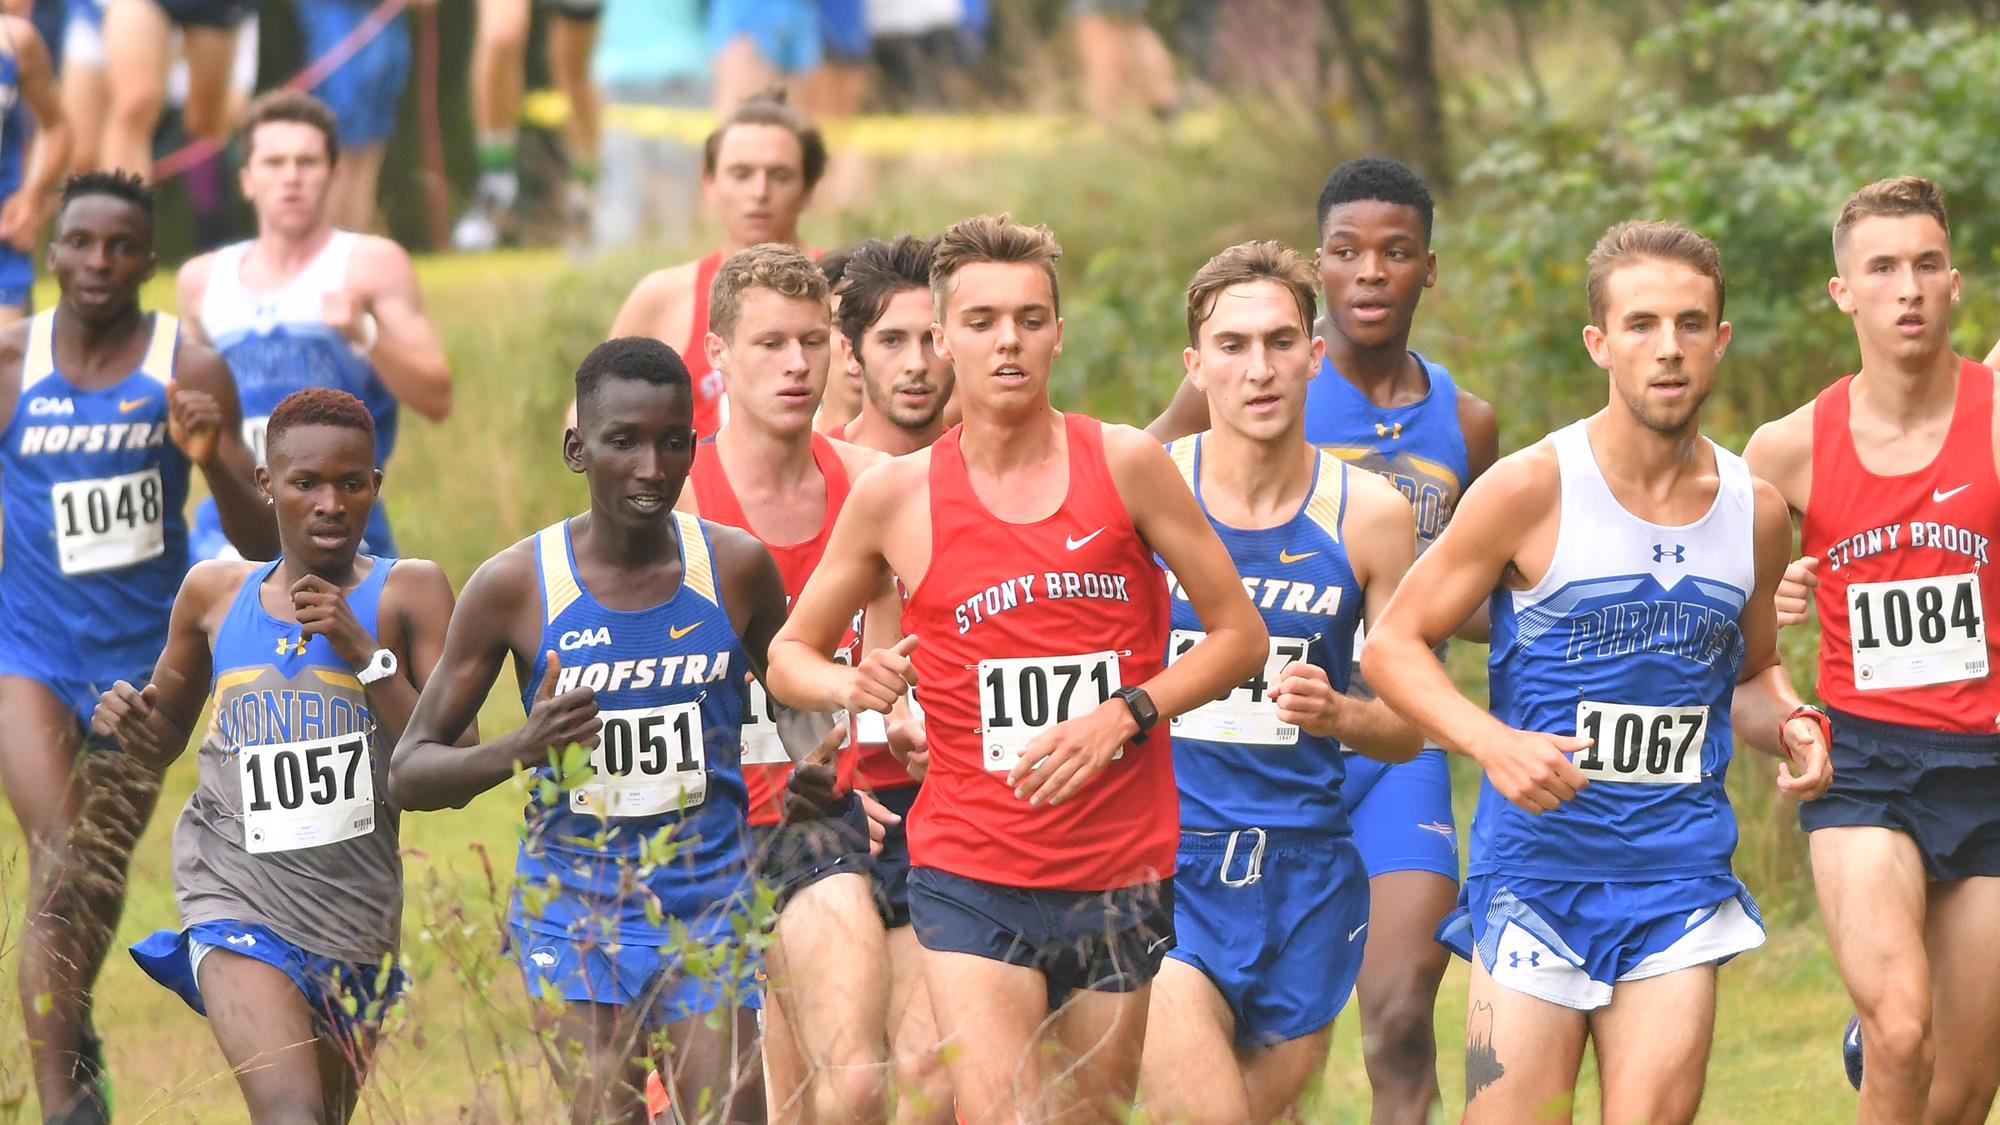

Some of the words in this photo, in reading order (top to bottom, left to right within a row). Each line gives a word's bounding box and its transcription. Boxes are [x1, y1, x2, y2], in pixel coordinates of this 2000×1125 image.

[20, 421, 167, 457] HOFSTRA
[61, 477, 160, 537] 1048
[1827, 523, 1900, 572] STONY
[1909, 521, 1989, 564] BROOK
[954, 574, 1035, 635] STONY
[1044, 571, 1129, 602] BROOK
[1854, 581, 1980, 649] 1084
[559, 626, 612, 650] CAA
[554, 651, 730, 697] HOFSTRA
[986, 660, 1110, 727] 1071
[586, 711, 699, 777] 051
[1579, 710, 1703, 775] 1067
[246, 739, 364, 812] 1057
